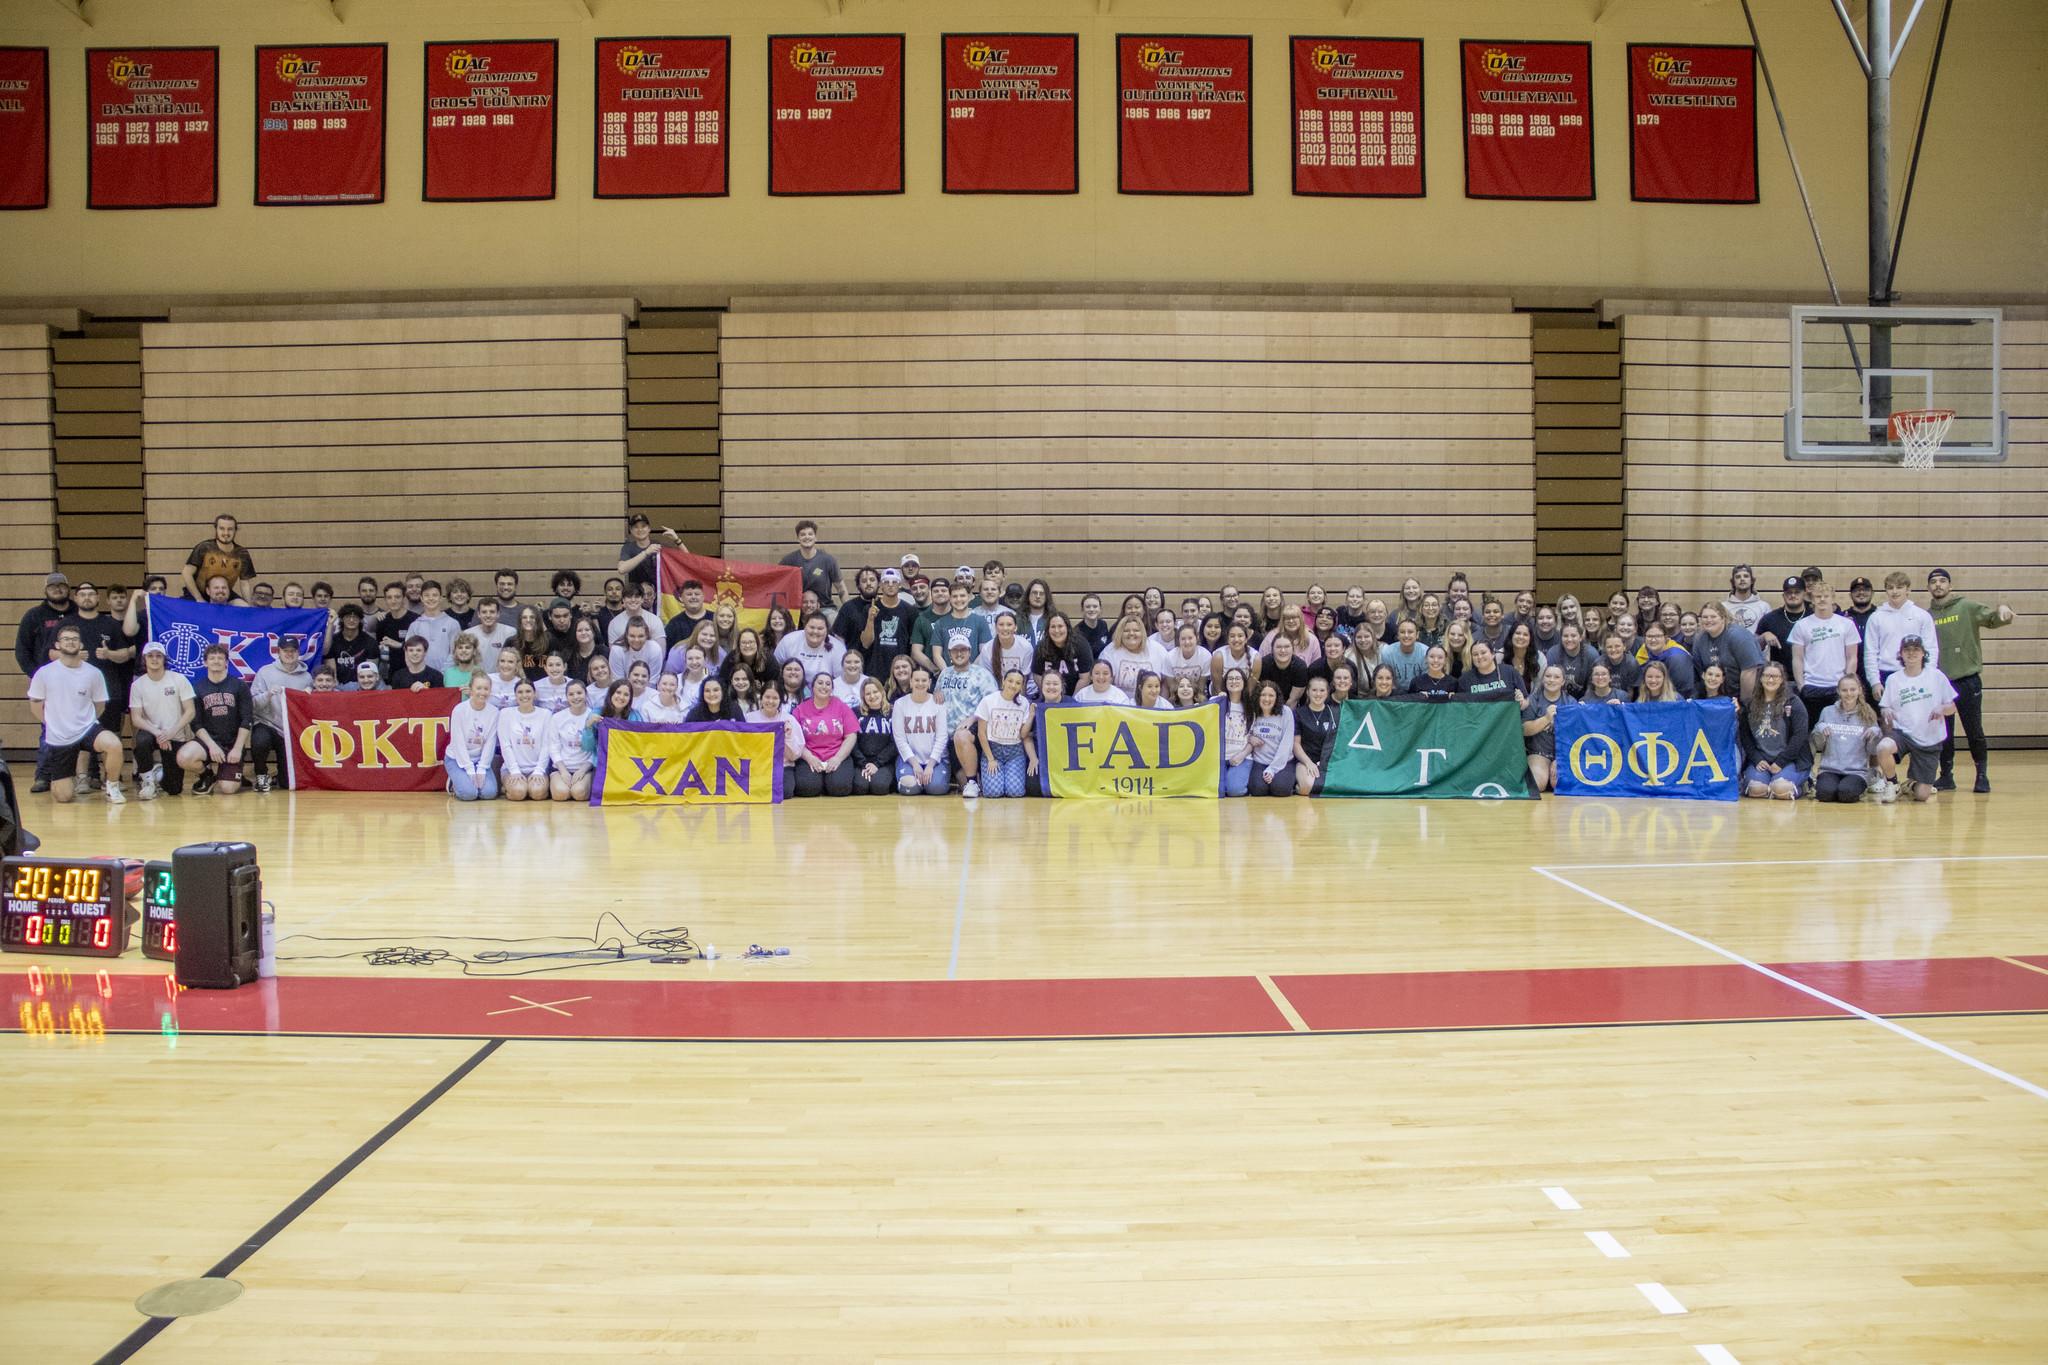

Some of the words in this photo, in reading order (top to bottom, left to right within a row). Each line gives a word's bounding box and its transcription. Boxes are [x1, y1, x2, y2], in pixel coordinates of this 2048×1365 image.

[624, 53, 662, 67] OAC
[798, 51, 836, 65] OAC
[972, 50, 1010, 63] OAC
[1146, 51, 1184, 65] OAC
[1320, 53, 1357, 67] OAC
[284, 61, 321, 75] OAC
[453, 57, 491, 71] OAC
[1490, 57, 1526, 70] OAC
[1656, 61, 1692, 74] OAC
[115, 64, 152, 78] OAC
[637, 69, 710, 79] CHAMPIONS
[810, 66, 884, 76] CHAMPIONS
[984, 66, 1058, 75] CHAMPIONS
[1159, 67, 1232, 77] CHAMPIONS
[1332, 69, 1404, 80] CHAMPIONS
[296, 76, 368, 87] CHAMPIONS
[466, 72, 538, 83] CHAMPIONS
[1502, 73, 1572, 83] CHAMPIONS
[1668, 76, 1737, 87] CHAMPIONS
[128, 80, 199, 90] CHAMPIONS
[817, 81, 856, 90] MEN'S
[980, 80, 1040, 90] WOMEN'S
[1155, 81, 1214, 90] WOMEN'S
[293, 90, 350, 100] WOMEN'S
[471, 87, 510, 97] MEN'S
[621, 88, 703, 100] FOOTBALL
[816, 89, 857, 102] GOLF
[948, 89, 1010, 101] INDOOR
[1016, 89, 1072, 101] TRACK
[1123, 89, 1193, 102] OUTDOOR
[1195, 90, 1246, 103] TRACK
[1317, 88, 1398, 100] SOFTBALL
[1478, 91, 1577, 104] VOLLEYBALL
[134, 94, 172, 104] MEN'S
[430, 97, 477, 109] CROSS
[483, 95, 551, 108] COUNTRY
[1648, 94, 1737, 107] WRESTLING
[102, 103, 203, 116] BASKETBALL
[270, 100, 371, 112] BASKETBALL
[603, 112, 627, 122] 1926
[634, 112, 658, 122] 1927
[664, 111, 688, 122] 1929
[694, 111, 719, 121] 1930
[808, 108, 832, 119] 1987
[951, 107, 975, 118] 1987
[1125, 108, 1149, 119] 1985
[1156, 108, 1180, 119] 1986
[1187, 109, 1211, 120] 1987
[1300, 110, 1323, 120] 1986
[1360, 111, 1384, 121] 1989
[1390, 112, 1414, 122] 1990
[293, 119, 317, 130] 1989
[323, 118, 347, 129] 1993
[432, 116, 456, 126] 1927
[462, 115, 486, 126] 1928
[493, 114, 514, 125] 1961
[1500, 114, 1524, 124] 1989
[1530, 115, 1551, 125] 1991
[1636, 114, 1660, 125] 1979
[96, 123, 119, 133] 1926
[125, 122, 149, 132] 1927
[156, 122, 179, 132] 1928
[185, 121, 209, 132] 1937
[603, 124, 624, 134] 1931
[634, 123, 658, 133] 1939
[664, 122, 688, 133] 1949
[695, 122, 719, 132] 1950
[1300, 121, 1323, 132] 1992
[1330, 122, 1354, 132] 1993
[1360, 122, 1384, 133] 1995
[1390, 123, 1414, 133] 1998
[1471, 125, 1494, 135] 1999
[1500, 126, 1524, 136] 2019
[1530, 126, 1555, 136] 2020
[96, 134, 117, 144] 1951
[126, 133, 149, 144] 1973
[156, 133, 179, 143] 1974
[603, 135, 627, 145] 1955
[634, 134, 658, 145] 1960
[664, 134, 688, 144] 1965
[694, 134, 719, 144] 1966
[1300, 132, 1324, 142] 1999
[1330, 134, 1356, 143] 2000
[1360, 134, 1384, 144] 2001
[1391, 134, 1416, 144] 2002
[603, 146, 627, 156] 1975
[1300, 144, 1326, 154] 2003
[1330, 145, 1356, 154] 2004
[1360, 145, 1386, 155] 2005
[1391, 145, 1416, 155] 2006
[1300, 155, 1326, 165] 2007
[1330, 156, 1356, 166] 2008
[1361, 156, 1385, 166] 2014
[1391, 156, 1415, 166] 2019
[1935, 615, 1959, 625] RHARTT
[1254, 721, 1283, 732] SKINGUM
[1061, 721, 1205, 771] FAD
[1112, 777, 1155, 796] 1914
[14, 867, 100, 902] 20:00
[8, 900, 38, 912] HOME
[72, 902, 106, 915] GUEST
[150, 906, 174, 920] HOME
[26, 915, 43, 944] 0
[42, 924, 53, 943] 0
[59, 925, 70, 944] 0
[94, 918, 111, 948] 0
